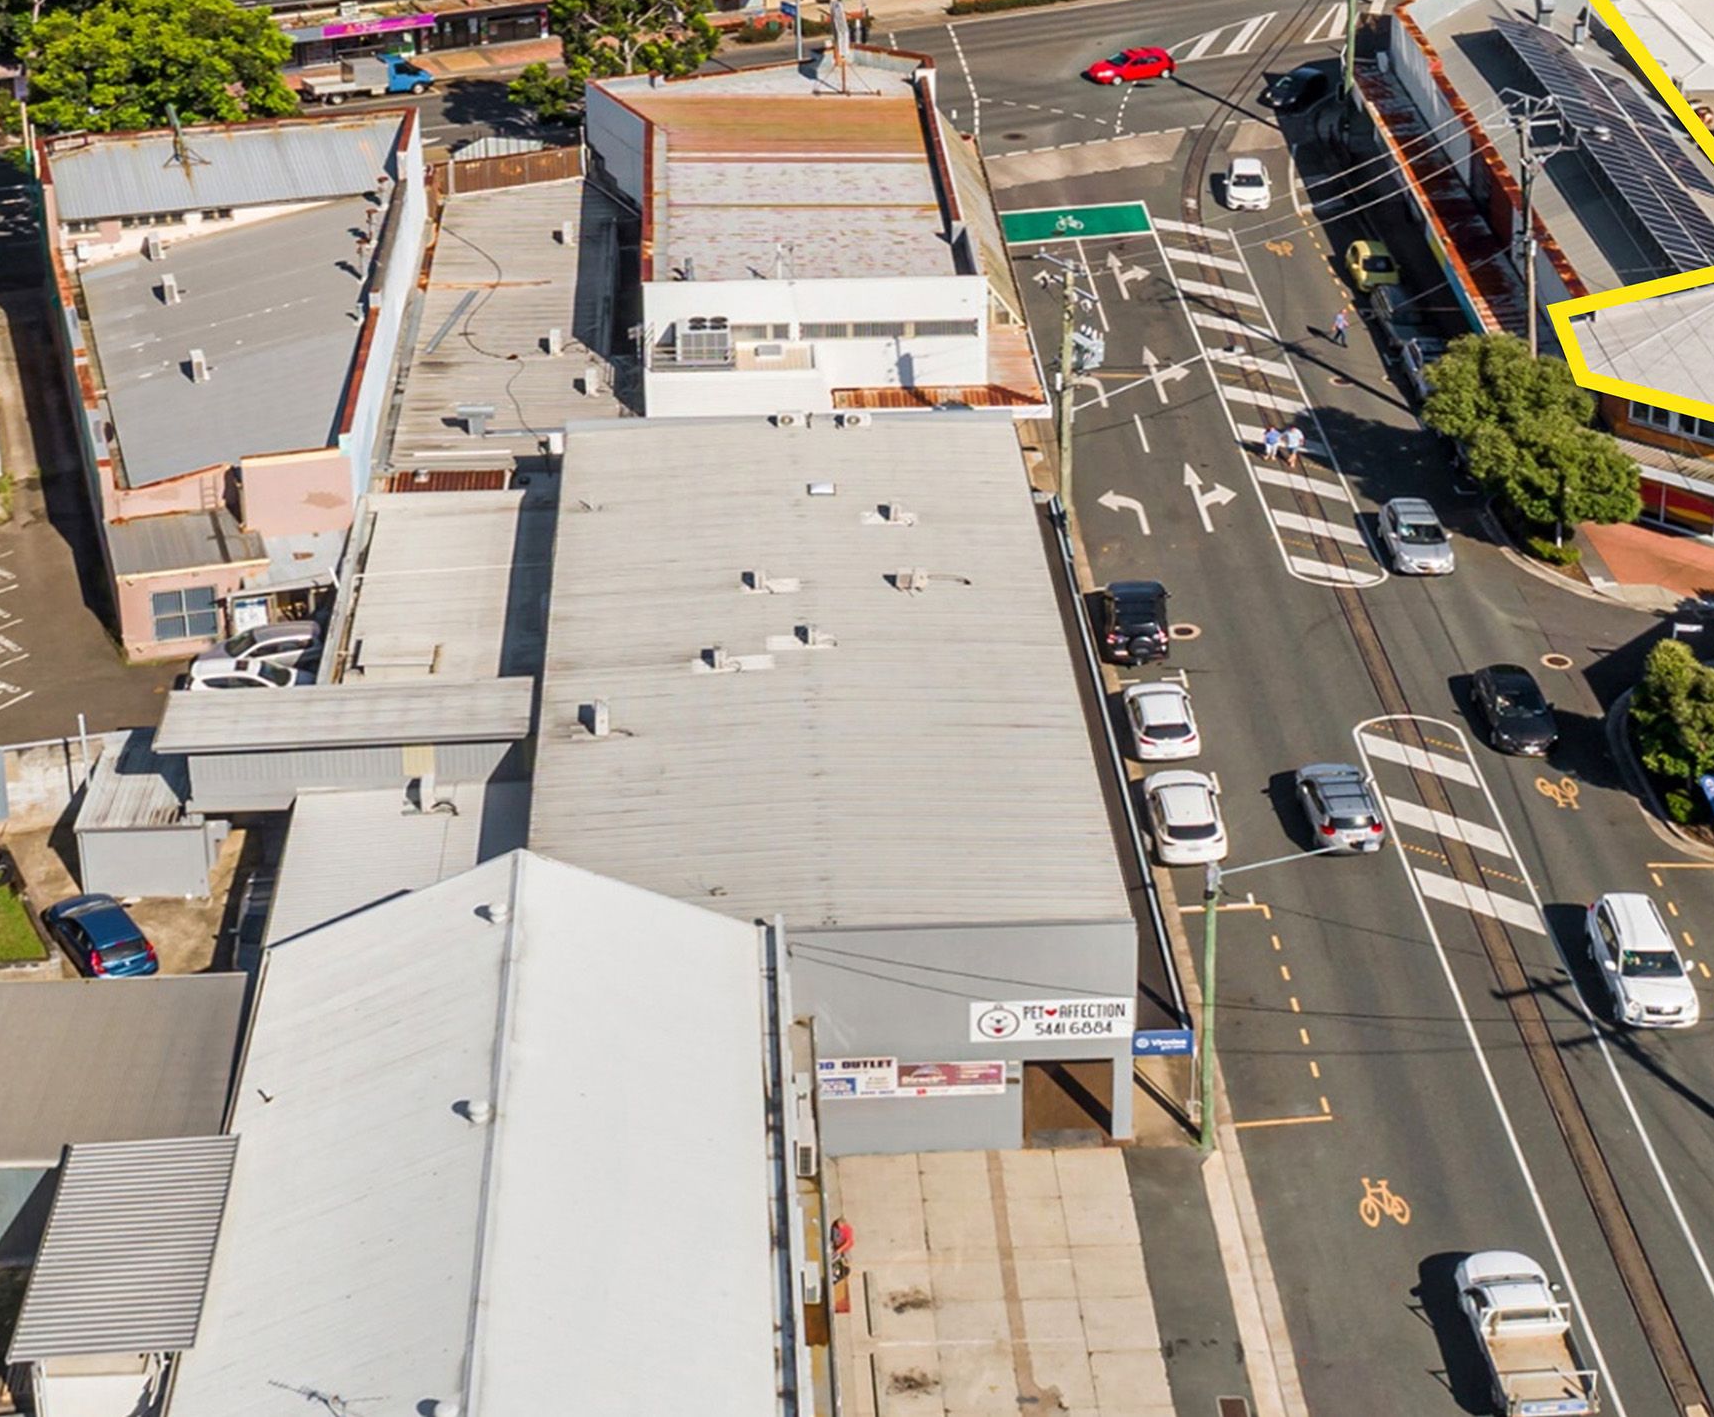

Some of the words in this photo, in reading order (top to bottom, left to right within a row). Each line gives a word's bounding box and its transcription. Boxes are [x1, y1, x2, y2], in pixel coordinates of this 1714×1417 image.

[1023, 1004, 1045, 1020] PET
[1058, 1002, 1126, 1019] AFFECTION
[1035, 1021, 1067, 1035] 5441
[1069, 1019, 1114, 1034] 6884
[841, 1058, 893, 1070] OUTLET
